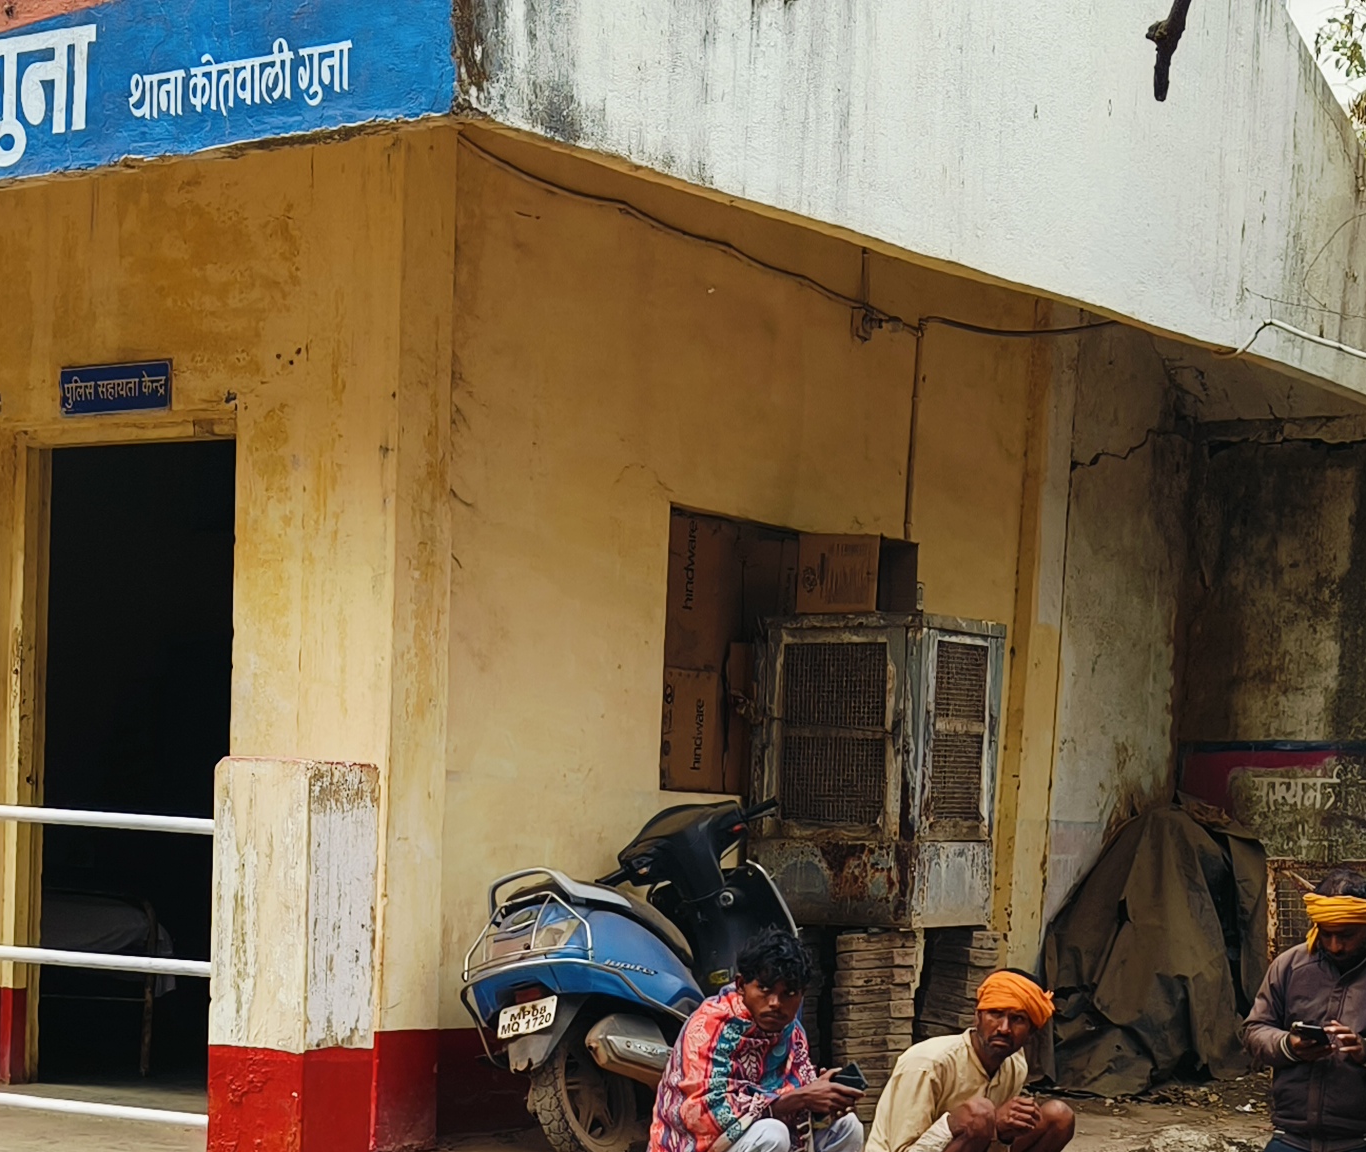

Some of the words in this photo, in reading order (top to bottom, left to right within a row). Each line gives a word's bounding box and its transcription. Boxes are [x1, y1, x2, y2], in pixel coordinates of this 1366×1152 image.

[128, 69, 185, 120] थाना
[189, 37, 294, 116] कोतवाली
[298, 40, 352, 106] गुना
[64, 376, 95, 409] पुलिस
[97, 378, 139, 400] सहायता
[142, 370, 166, 397] केन्द्र
[501, 1022, 520, 1035] MQ
[524, 1012, 552, 1030] 1720
[510, 1006, 547, 1022] MP08
